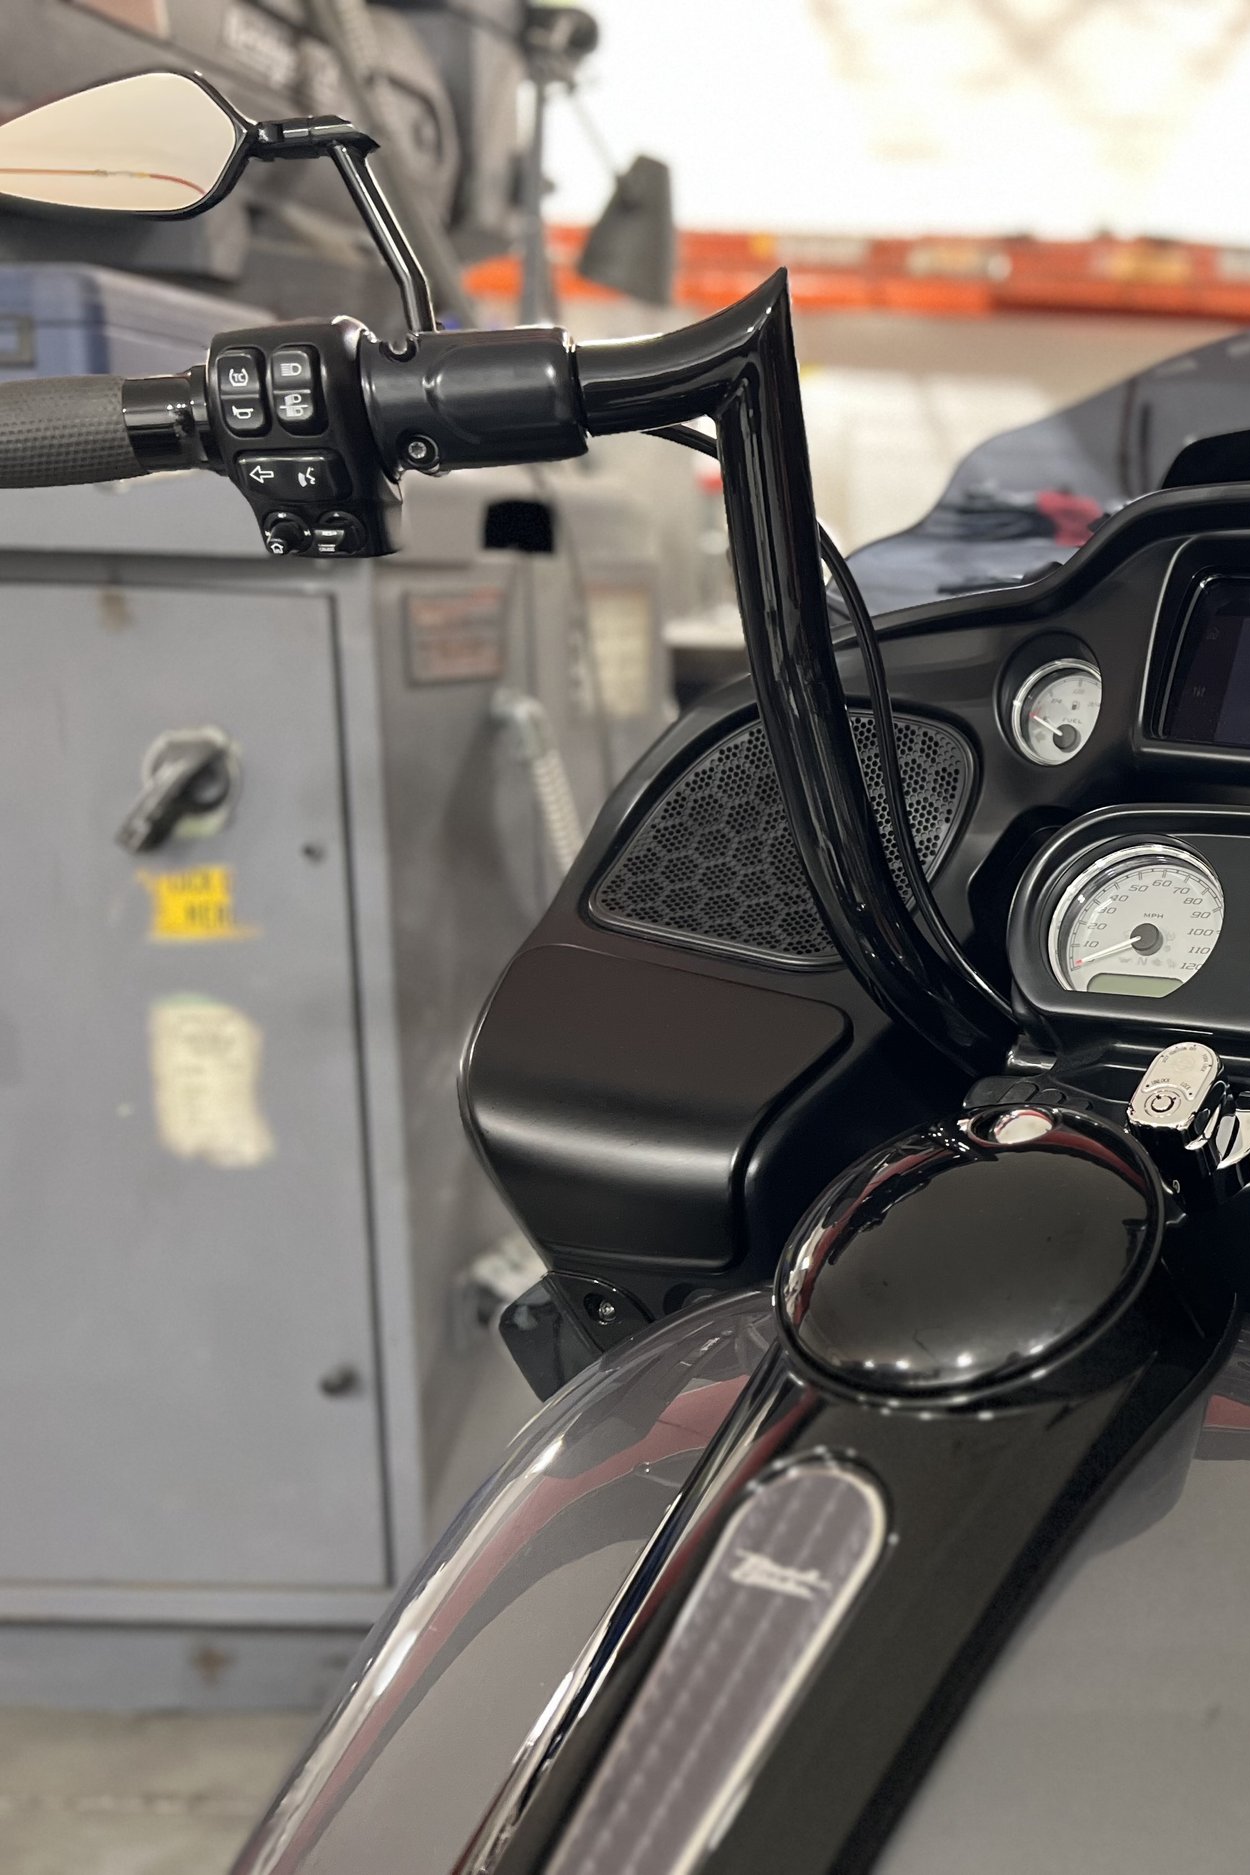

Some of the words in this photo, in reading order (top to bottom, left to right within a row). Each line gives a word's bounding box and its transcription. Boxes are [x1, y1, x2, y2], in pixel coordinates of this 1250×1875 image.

[232, 373, 244, 382] TC
[1152, 879, 1172, 887] 60
[1128, 884, 1149, 893] 50
[1173, 887, 1191, 895] 70
[1183, 897, 1203, 905] 80
[1190, 911, 1211, 919] 90
[1187, 928, 1214, 936] 100
[1083, 940, 1099, 948] 10
[1188, 946, 1211, 954] 110
